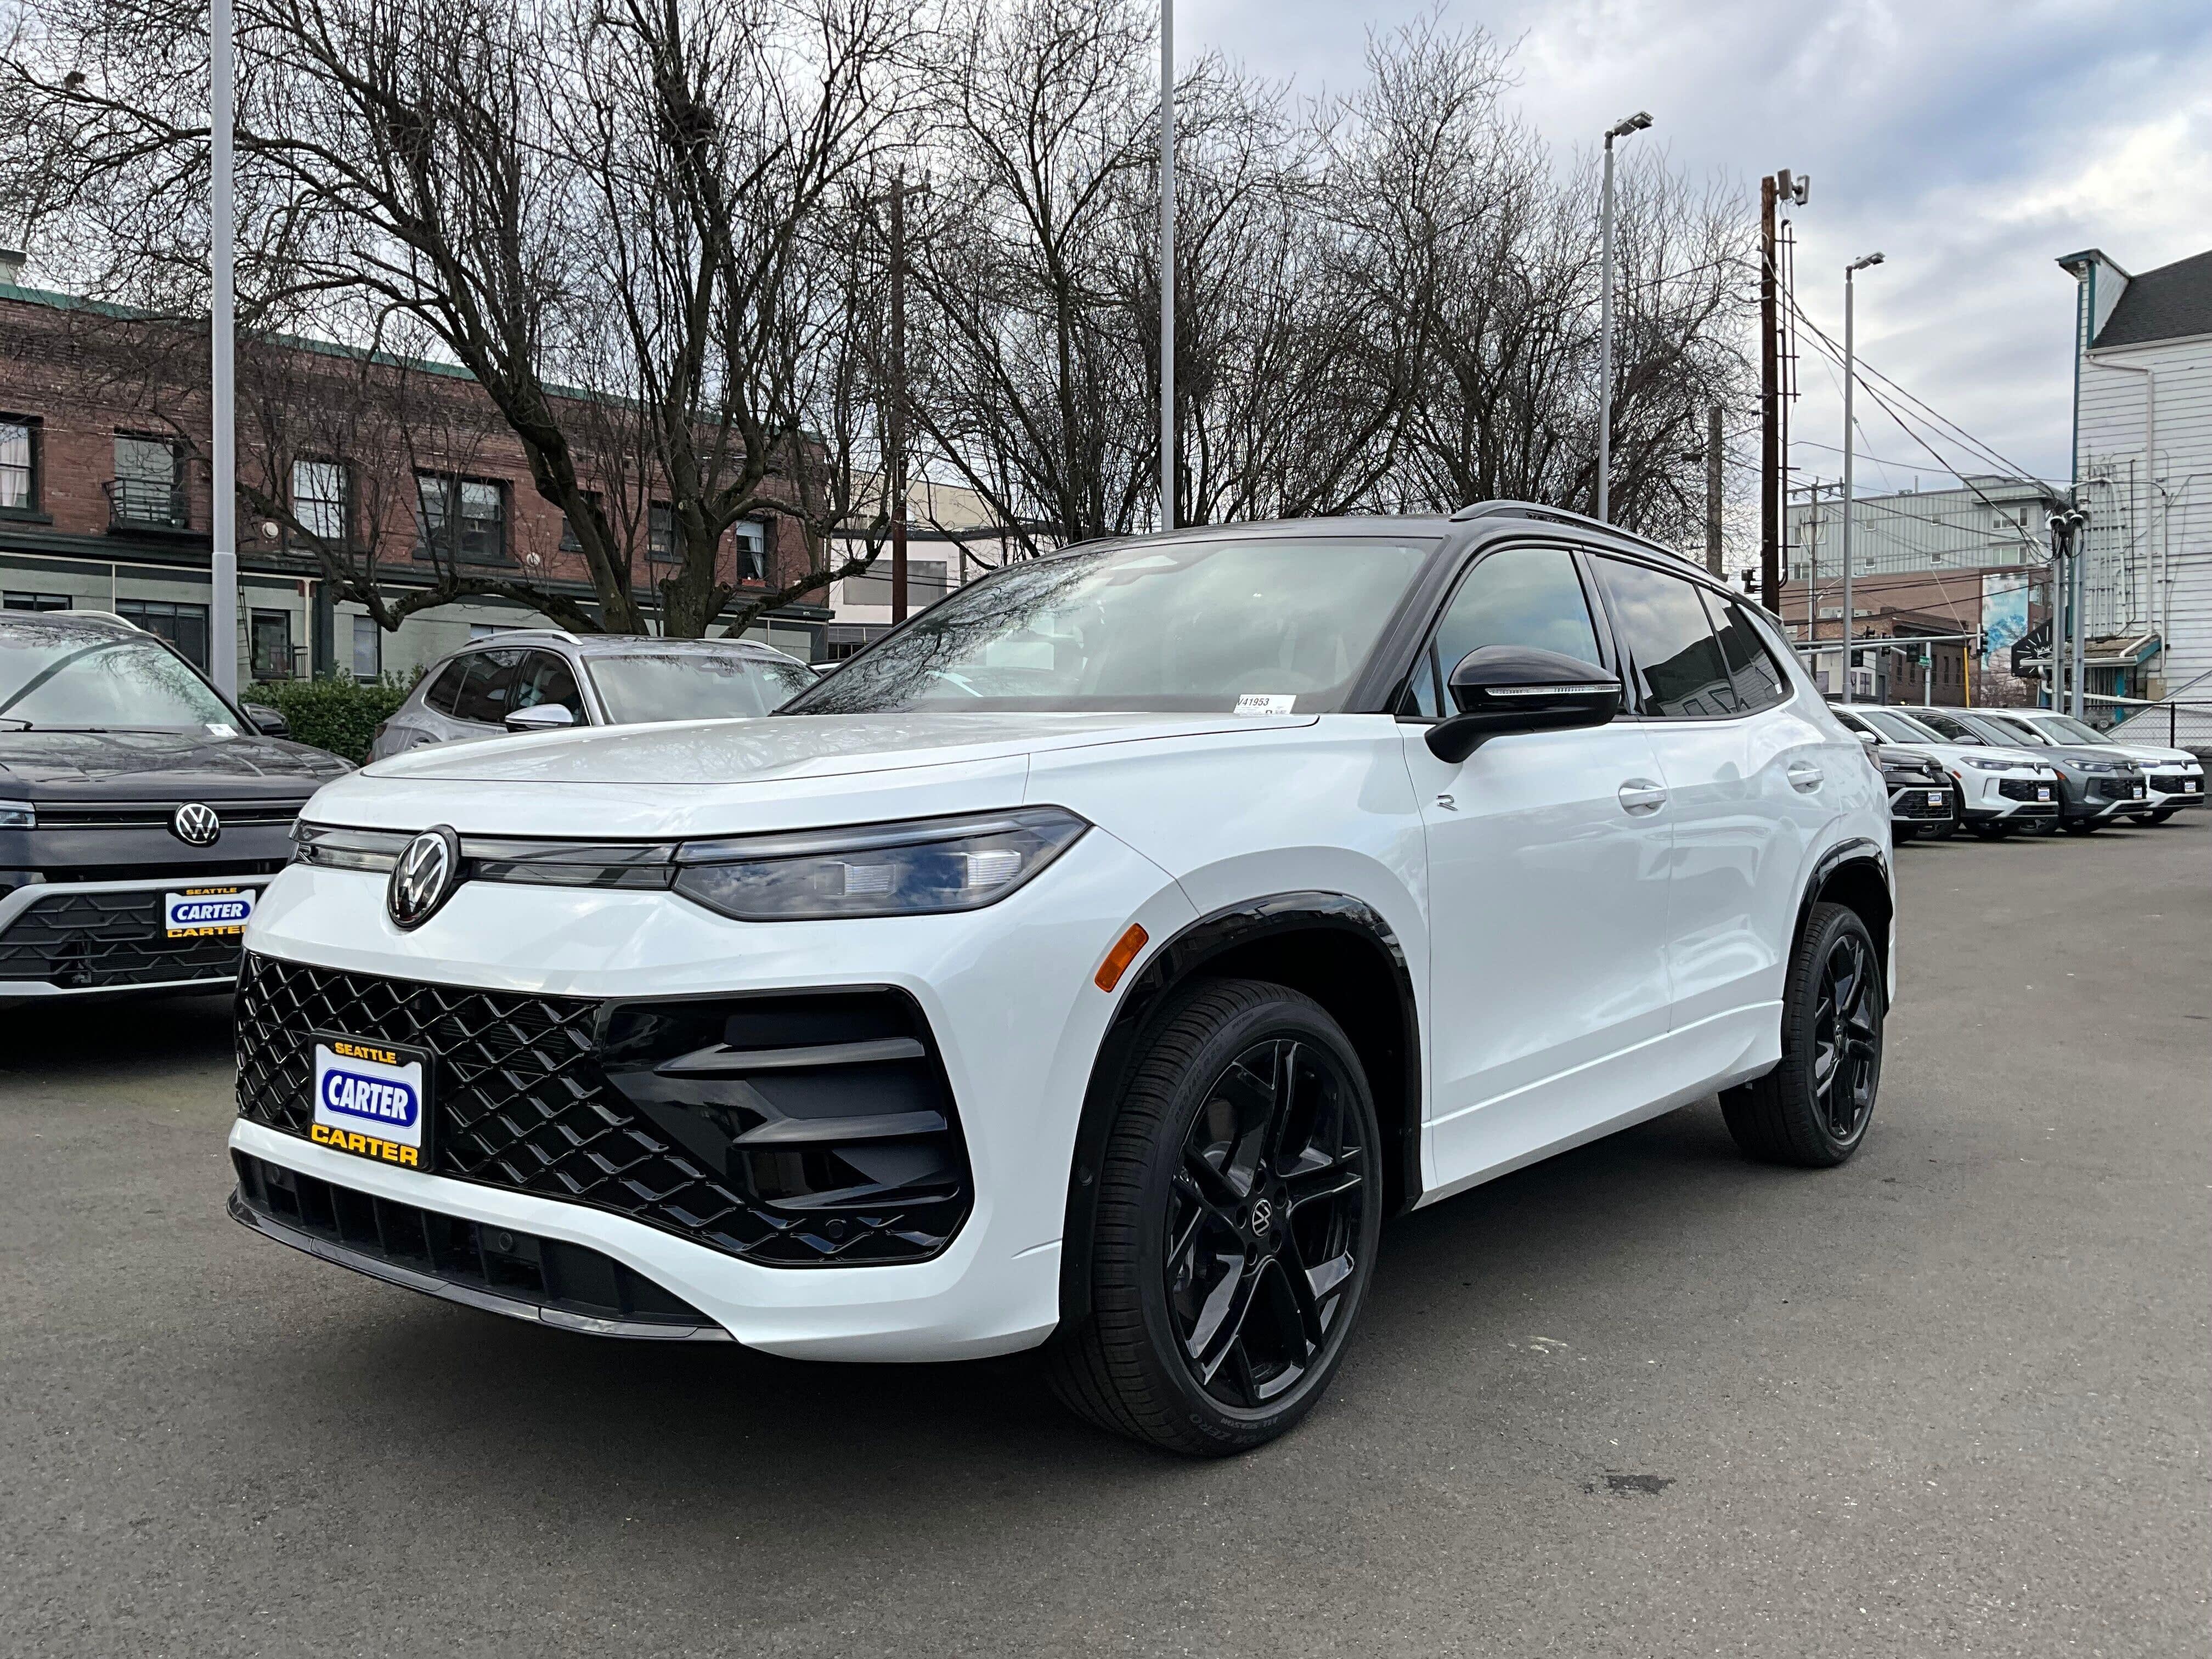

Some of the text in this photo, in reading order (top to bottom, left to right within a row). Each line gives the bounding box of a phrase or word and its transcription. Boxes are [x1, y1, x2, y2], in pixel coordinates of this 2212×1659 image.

[1237, 698, 1269, 706] V41953
[186, 887, 238, 895] SEATTLE
[177, 904, 243, 920] CARTER
[334, 1042, 397, 1064] SEATTLE
[329, 1075, 408, 1120] CARTER
[311, 1124, 418, 1166] CARTER
